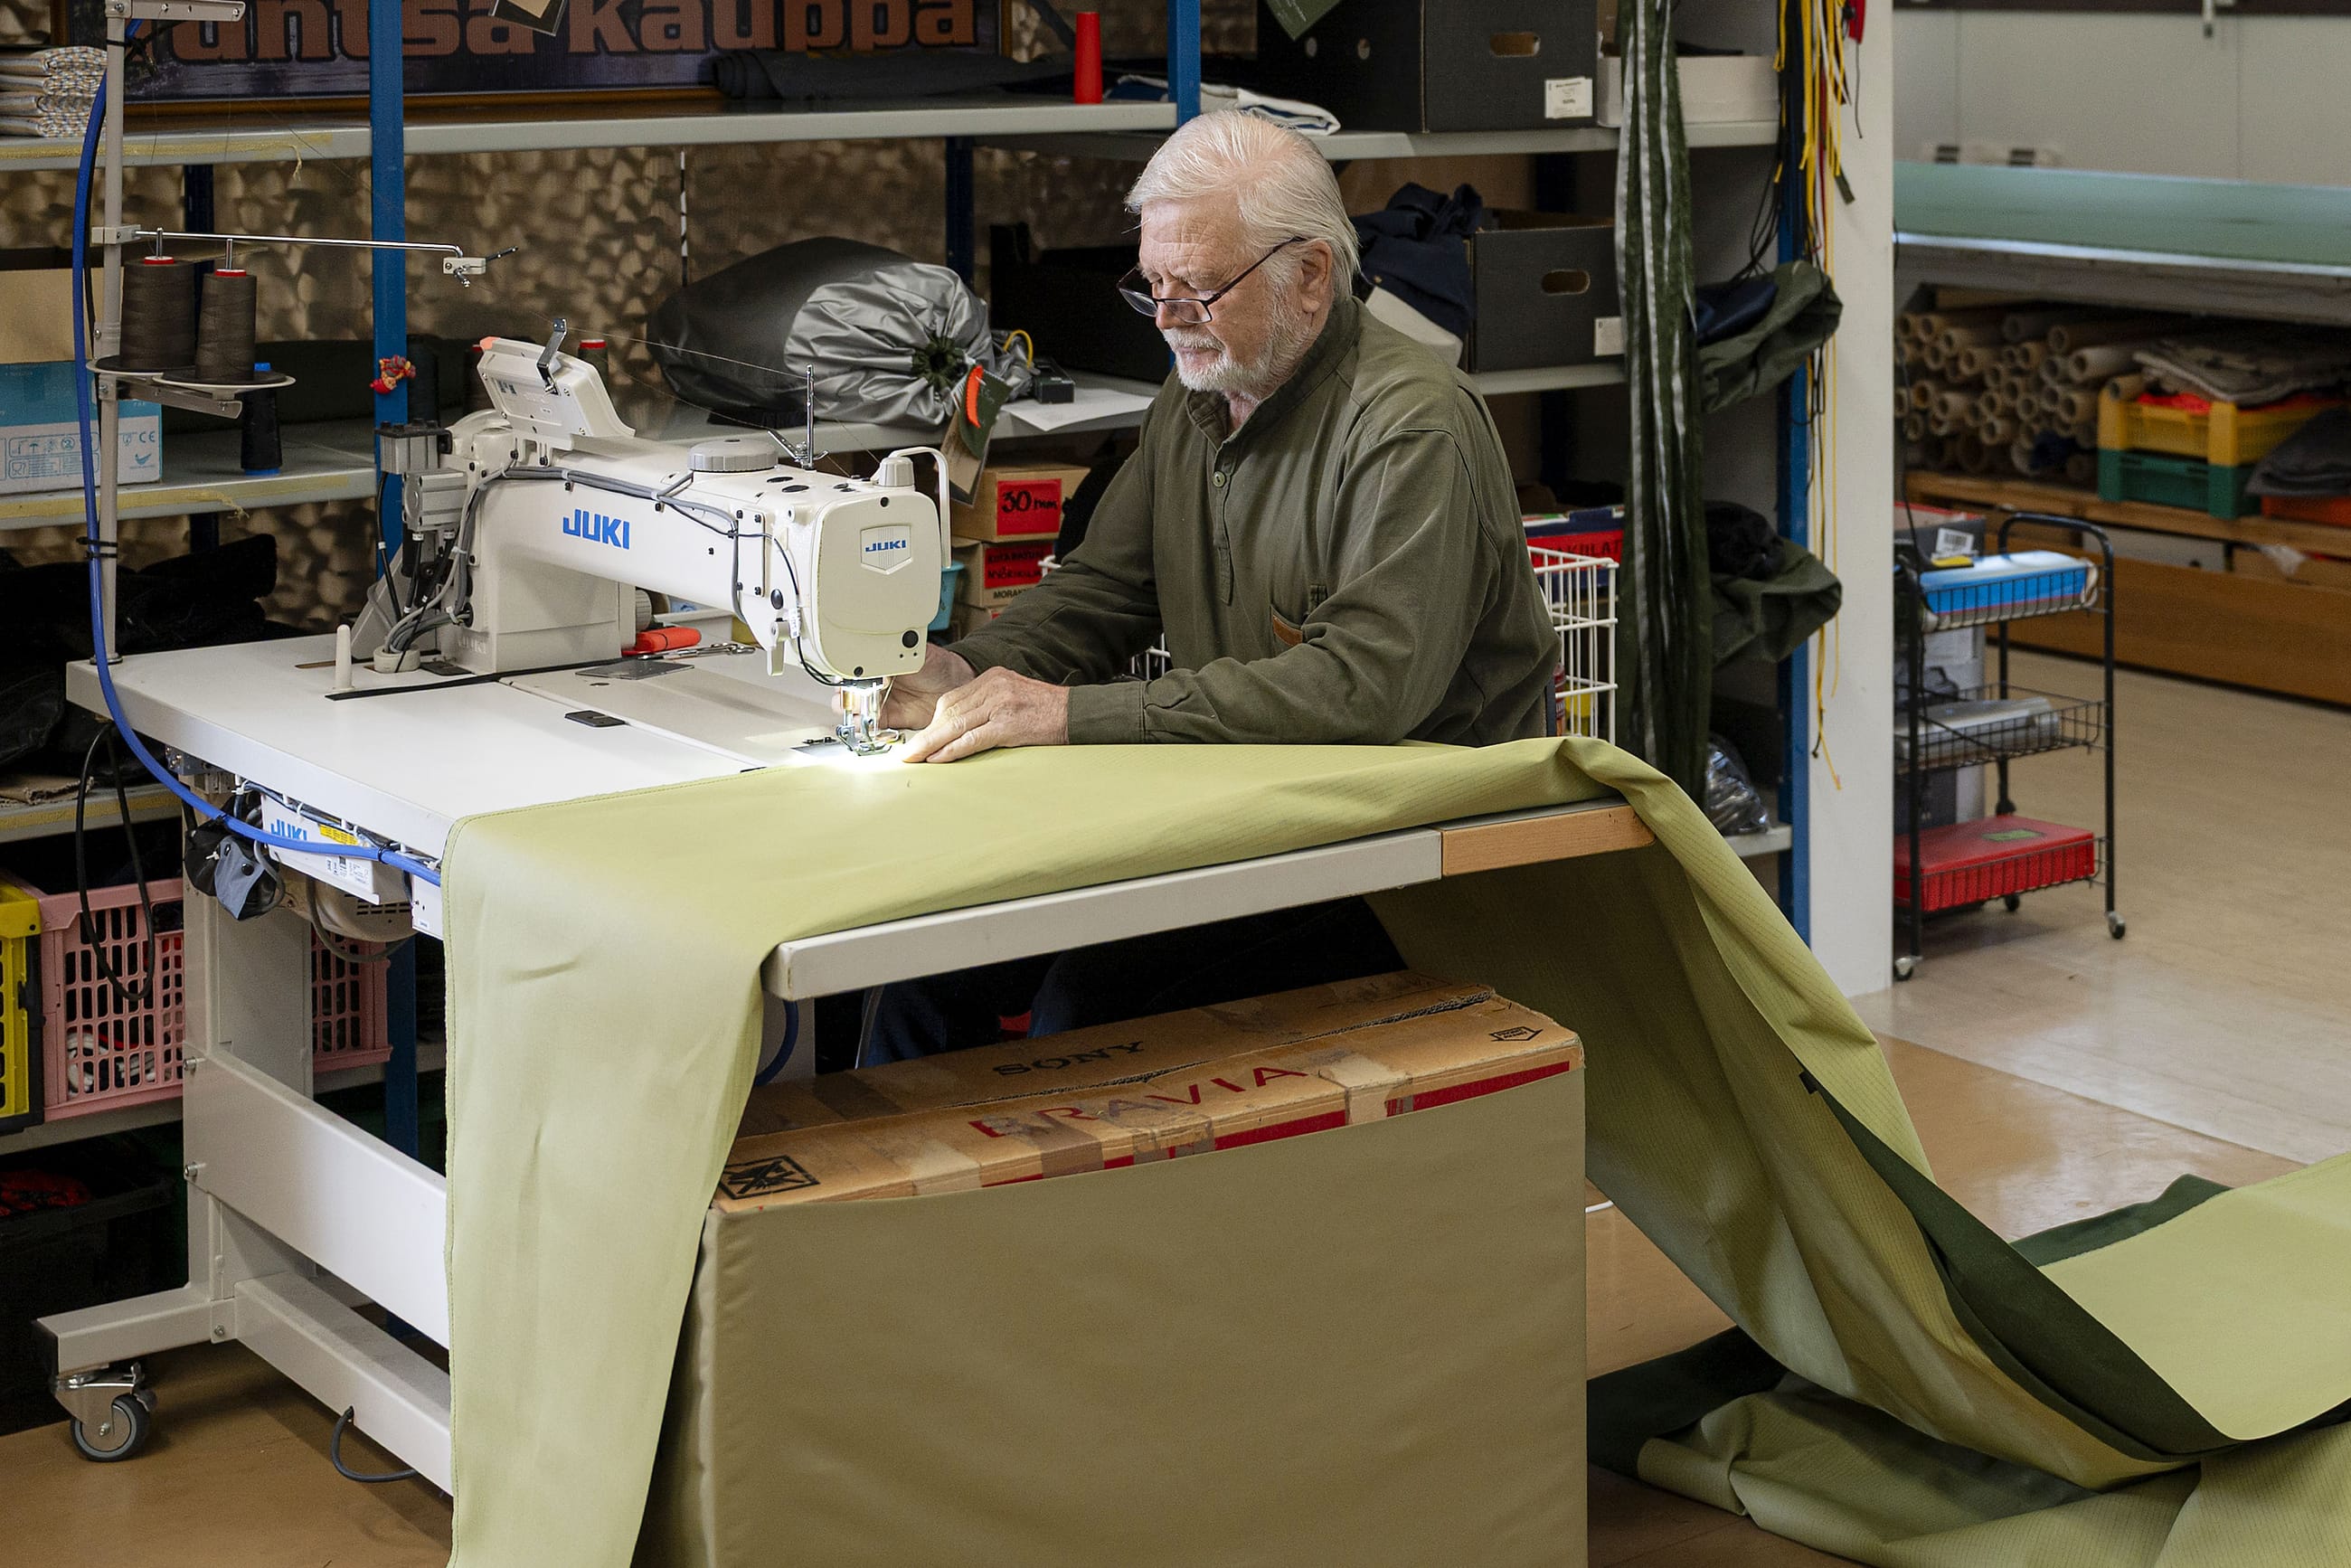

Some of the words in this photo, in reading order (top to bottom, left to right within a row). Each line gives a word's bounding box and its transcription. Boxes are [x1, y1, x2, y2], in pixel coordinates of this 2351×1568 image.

[124, 0, 536, 61] untsa
[569, 0, 977, 53] kauppa
[1002, 490, 1032, 513] 30
[563, 508, 630, 550] JUKI
[864, 540, 906, 552] JUKI
[270, 818, 307, 841] JUKI
[992, 1041, 1145, 1075] SONY
